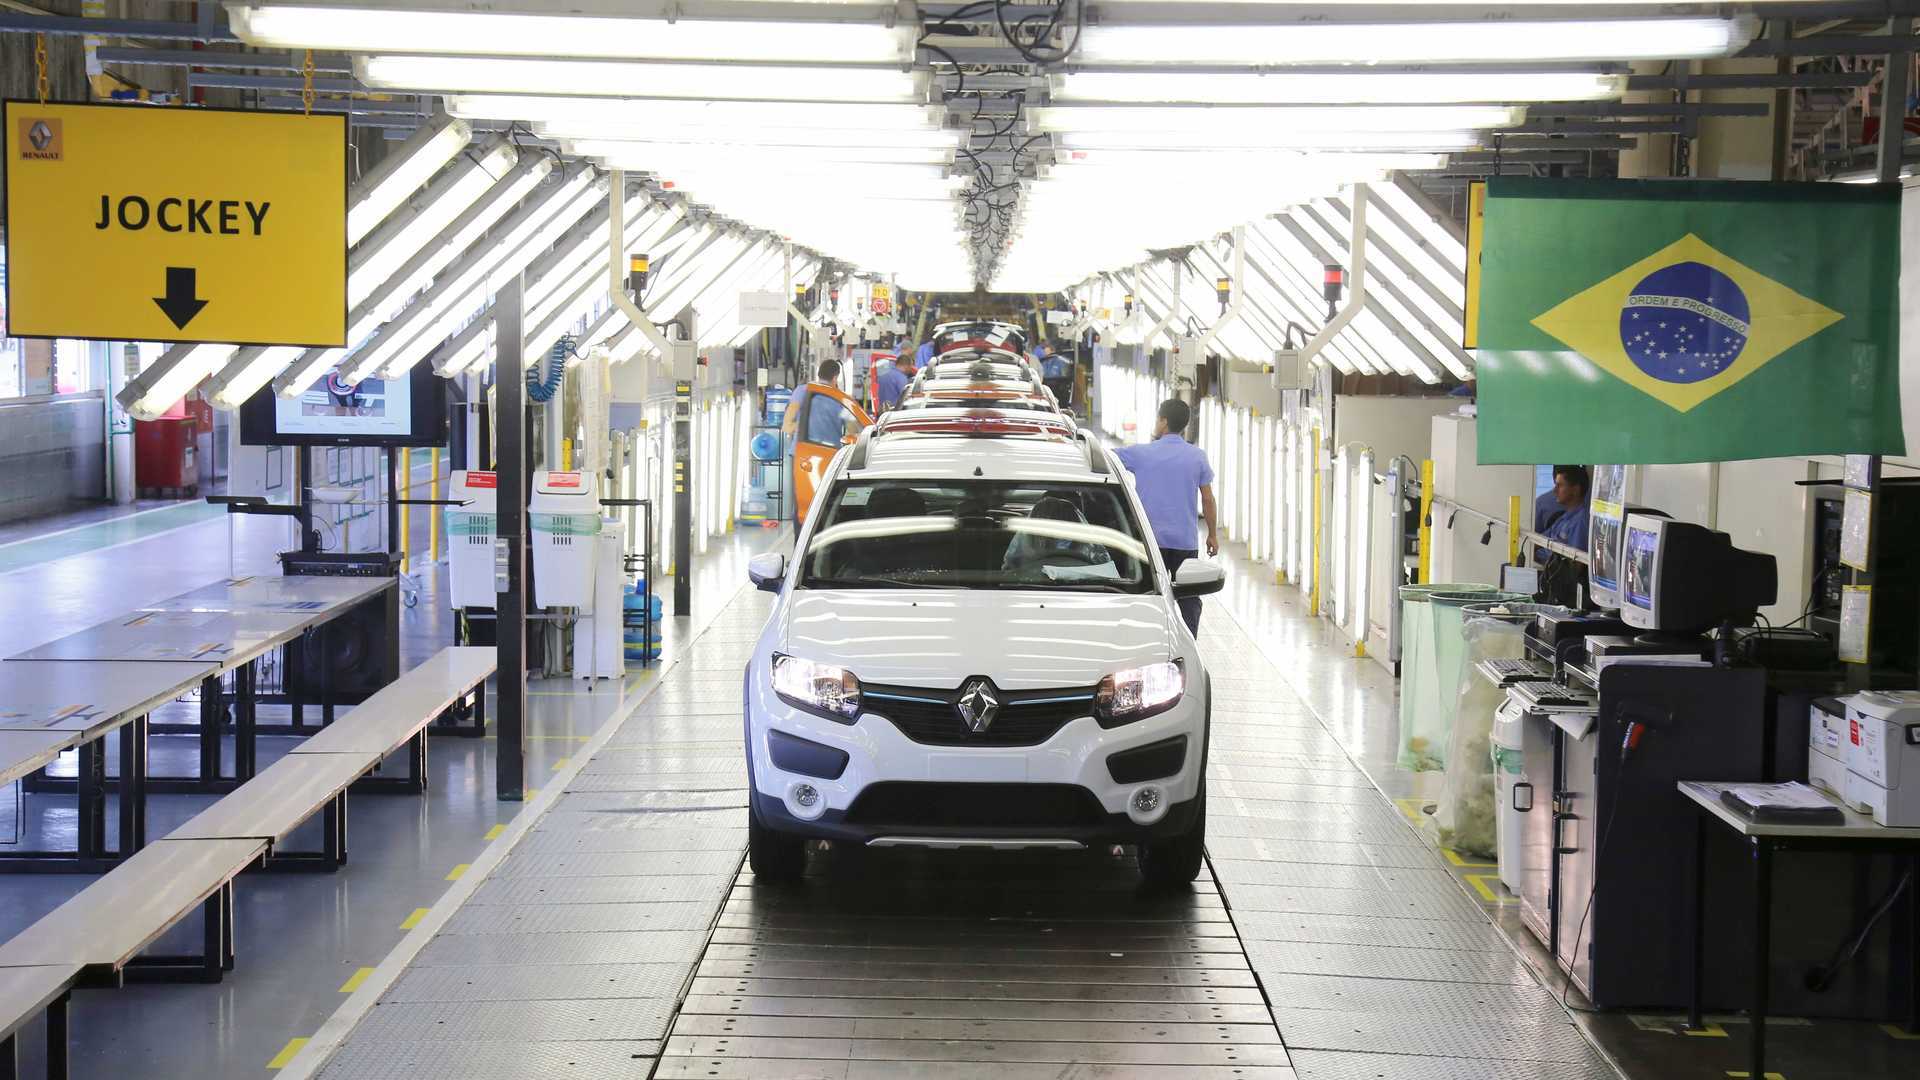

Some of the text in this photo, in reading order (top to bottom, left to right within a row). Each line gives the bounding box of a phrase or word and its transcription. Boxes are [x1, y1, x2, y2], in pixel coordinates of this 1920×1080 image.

[22, 151, 59, 160] RENAULT
[95, 195, 271, 236] JOCKEY
[1629, 296, 1746, 333] ORDEM E PROGRESSO
